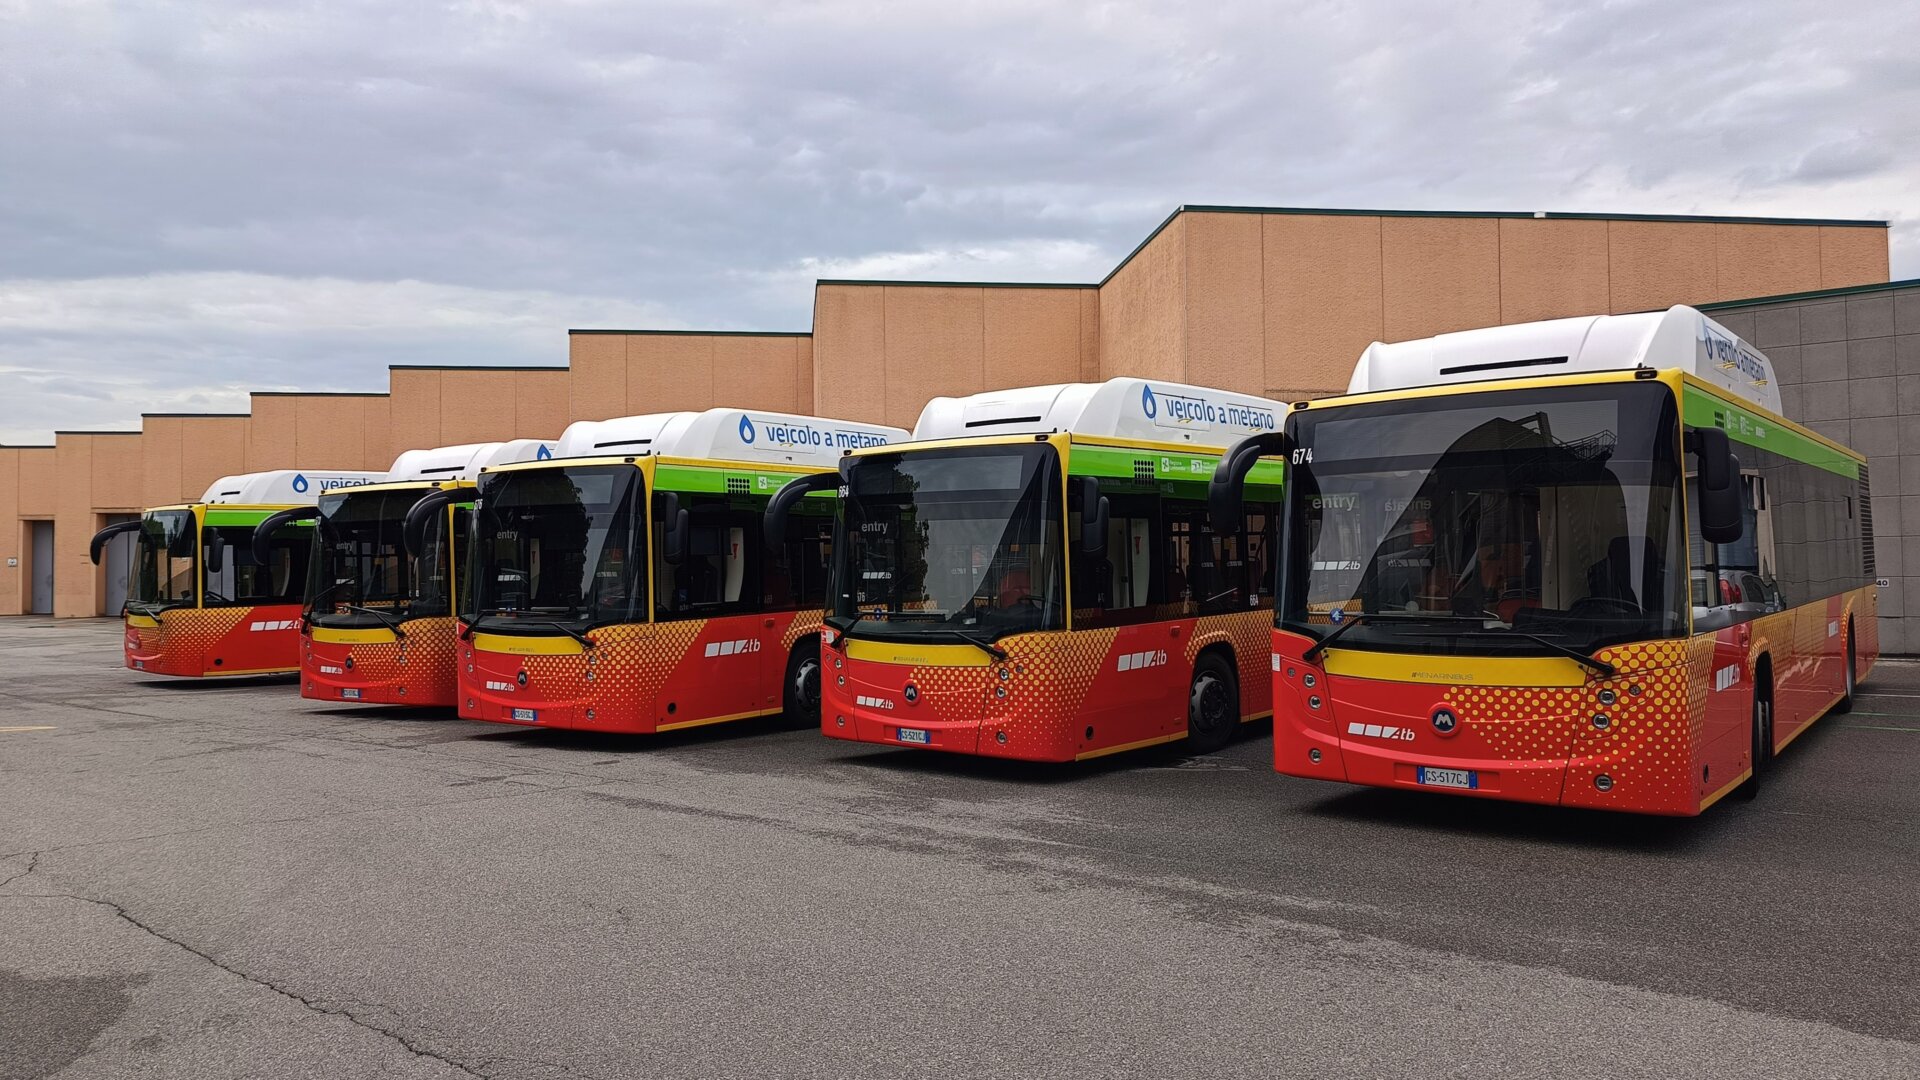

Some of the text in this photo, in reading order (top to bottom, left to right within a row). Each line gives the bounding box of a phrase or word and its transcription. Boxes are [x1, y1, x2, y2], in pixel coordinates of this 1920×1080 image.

[1166, 395, 1274, 430] veicolo a metano
[766, 423, 820, 446] veicolo
[824, 432, 833, 447] a
[1292, 448, 1313, 465] 674
[320, 477, 376, 490] veicol
[1312, 495, 1355, 511] entry
[497, 530, 518, 541] entry
[861, 521, 888, 535] entry
[1435, 713, 1453, 726] M
